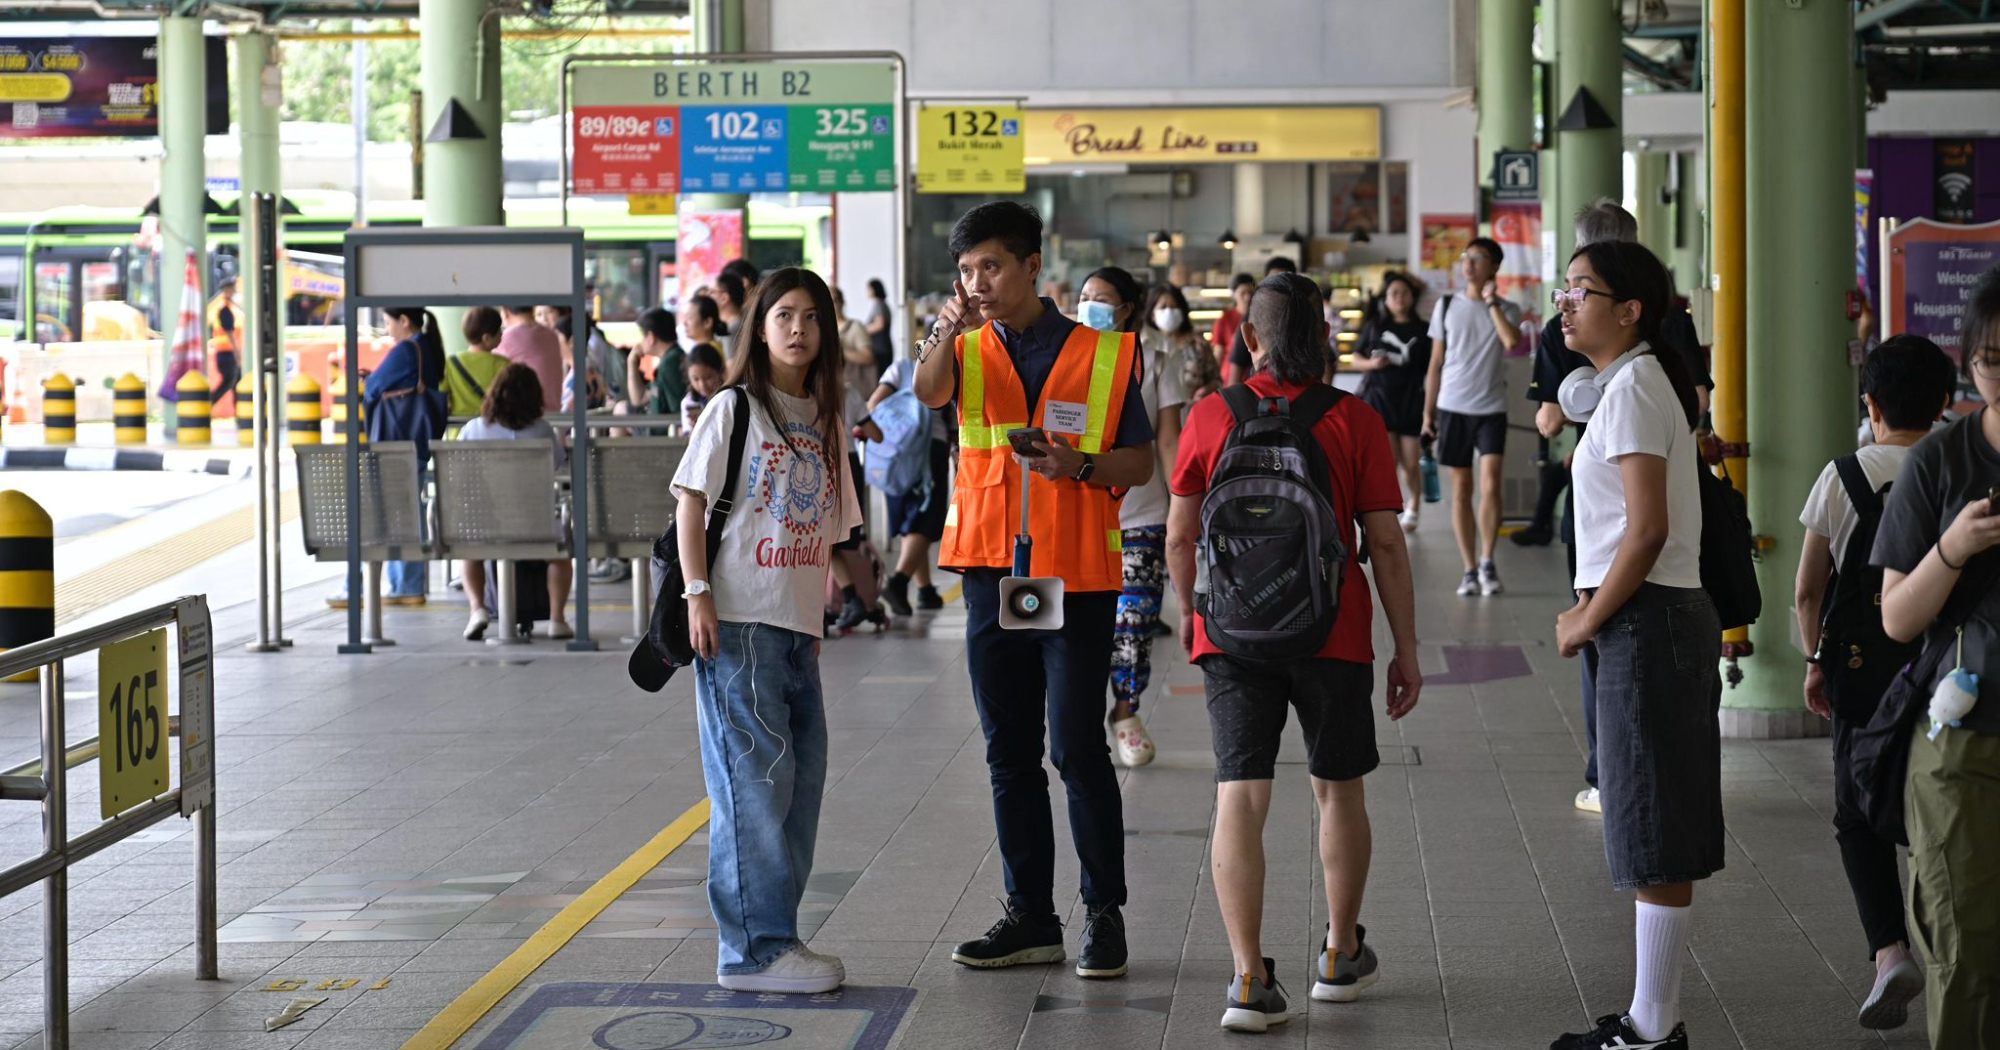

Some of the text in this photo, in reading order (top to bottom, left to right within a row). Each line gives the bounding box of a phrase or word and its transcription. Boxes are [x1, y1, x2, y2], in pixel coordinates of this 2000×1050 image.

[654, 71, 811, 97] BERTH B2
[579, 115, 650, 138] 89/89e
[705, 112, 759, 139] 102
[816, 109, 868, 136] 325
[943, 111, 998, 136] 132
[938, 140, 1003, 150] Bukit Merah
[1065, 123, 1208, 155] Bread Line
[1937, 271, 1981, 285] Welco
[109, 669, 160, 773] 165
